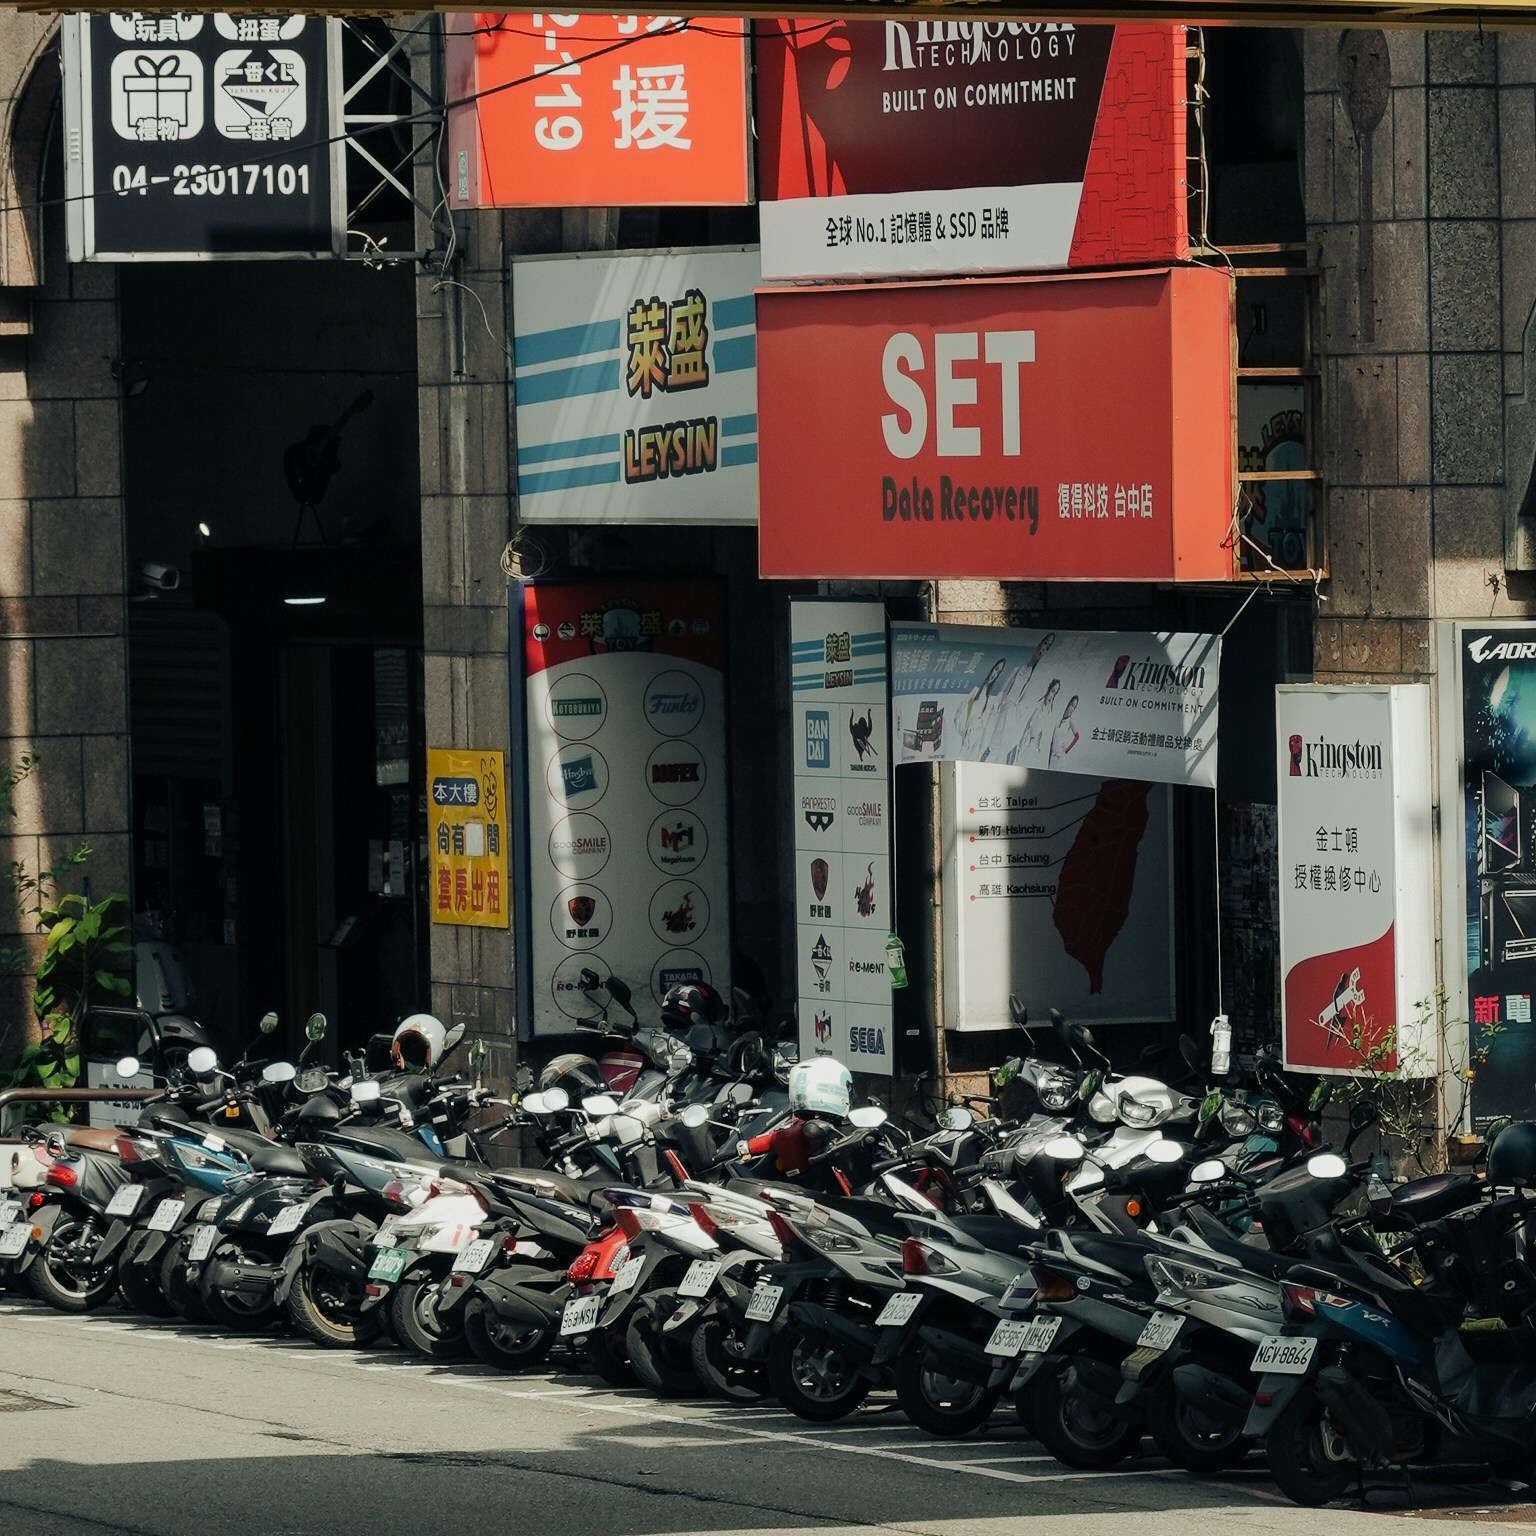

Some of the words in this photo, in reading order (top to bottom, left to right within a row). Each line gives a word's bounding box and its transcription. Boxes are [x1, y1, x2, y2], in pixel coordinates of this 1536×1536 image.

[135, 18, 179, 42] 玩具
[239, 18, 282, 42] 扭蛋
[917, 33, 1076, 68] TECHNOLOGY
[225, 61, 295, 82] 一番くじ
[883, 88, 925, 114] BUILT
[933, 86, 958, 109] ON
[965, 76, 1077, 107] COMMITMENT
[136, 117, 180, 141] 禮物
[112, 164, 309, 195] 04-23017101
[825, 216, 853, 247] 全球
[856, 214, 887, 244] No.1
[891, 210, 932, 245] 記憶體
[935, 217, 947, 241] &
[949, 210, 977, 239] SSD
[981, 207, 1010, 241] 品牌
[881, 329, 1037, 459] SET
[624, 416, 718, 484] LEYSIN
[882, 474, 935, 522] Data
[939, 475, 1039, 536] Recovery
[1057, 482, 1109, 519] 復得科技
[1114, 482, 1153, 519] 台中店
[824, 669, 854, 689] LEYSIN
[1121, 655, 1206, 693] Kingston
[1136, 683, 1205, 697] TECHNOLOGY
[649, 694, 700, 714] Funko
[1099, 695, 1123, 706] BUILT
[1125, 698, 1139, 708] ON
[1141, 700, 1204, 714] COMMITMENT
[807, 719, 828, 739] BAN
[807, 740, 824, 761] DAI
[1306, 735, 1383, 778] Kingston
[1320, 768, 1384, 780] TECHNOLOGY
[434, 782, 477, 804] 本大樓
[978, 796, 1002, 808] 台北
[1006, 797, 1038, 807] Taipei
[437, 822, 465, 856] 尚有
[487, 823, 500, 857] 間
[978, 825, 1002, 836] 新竹
[1006, 824, 1045, 835] Hsinchu
[1315, 826, 1359, 853] 金士頓
[979, 854, 1002, 866] 台中
[1006, 853, 1050, 865] Taichung
[438, 866, 501, 914] 套房出租
[979, 884, 1002, 895] 高雄
[1006, 883, 1056, 895] Kaohsiung
[1294, 863, 1382, 894] 授權換修中心
[850, 1026, 886, 1055] SEGA
[1255, 1346, 1312, 1365] NGV-8866
